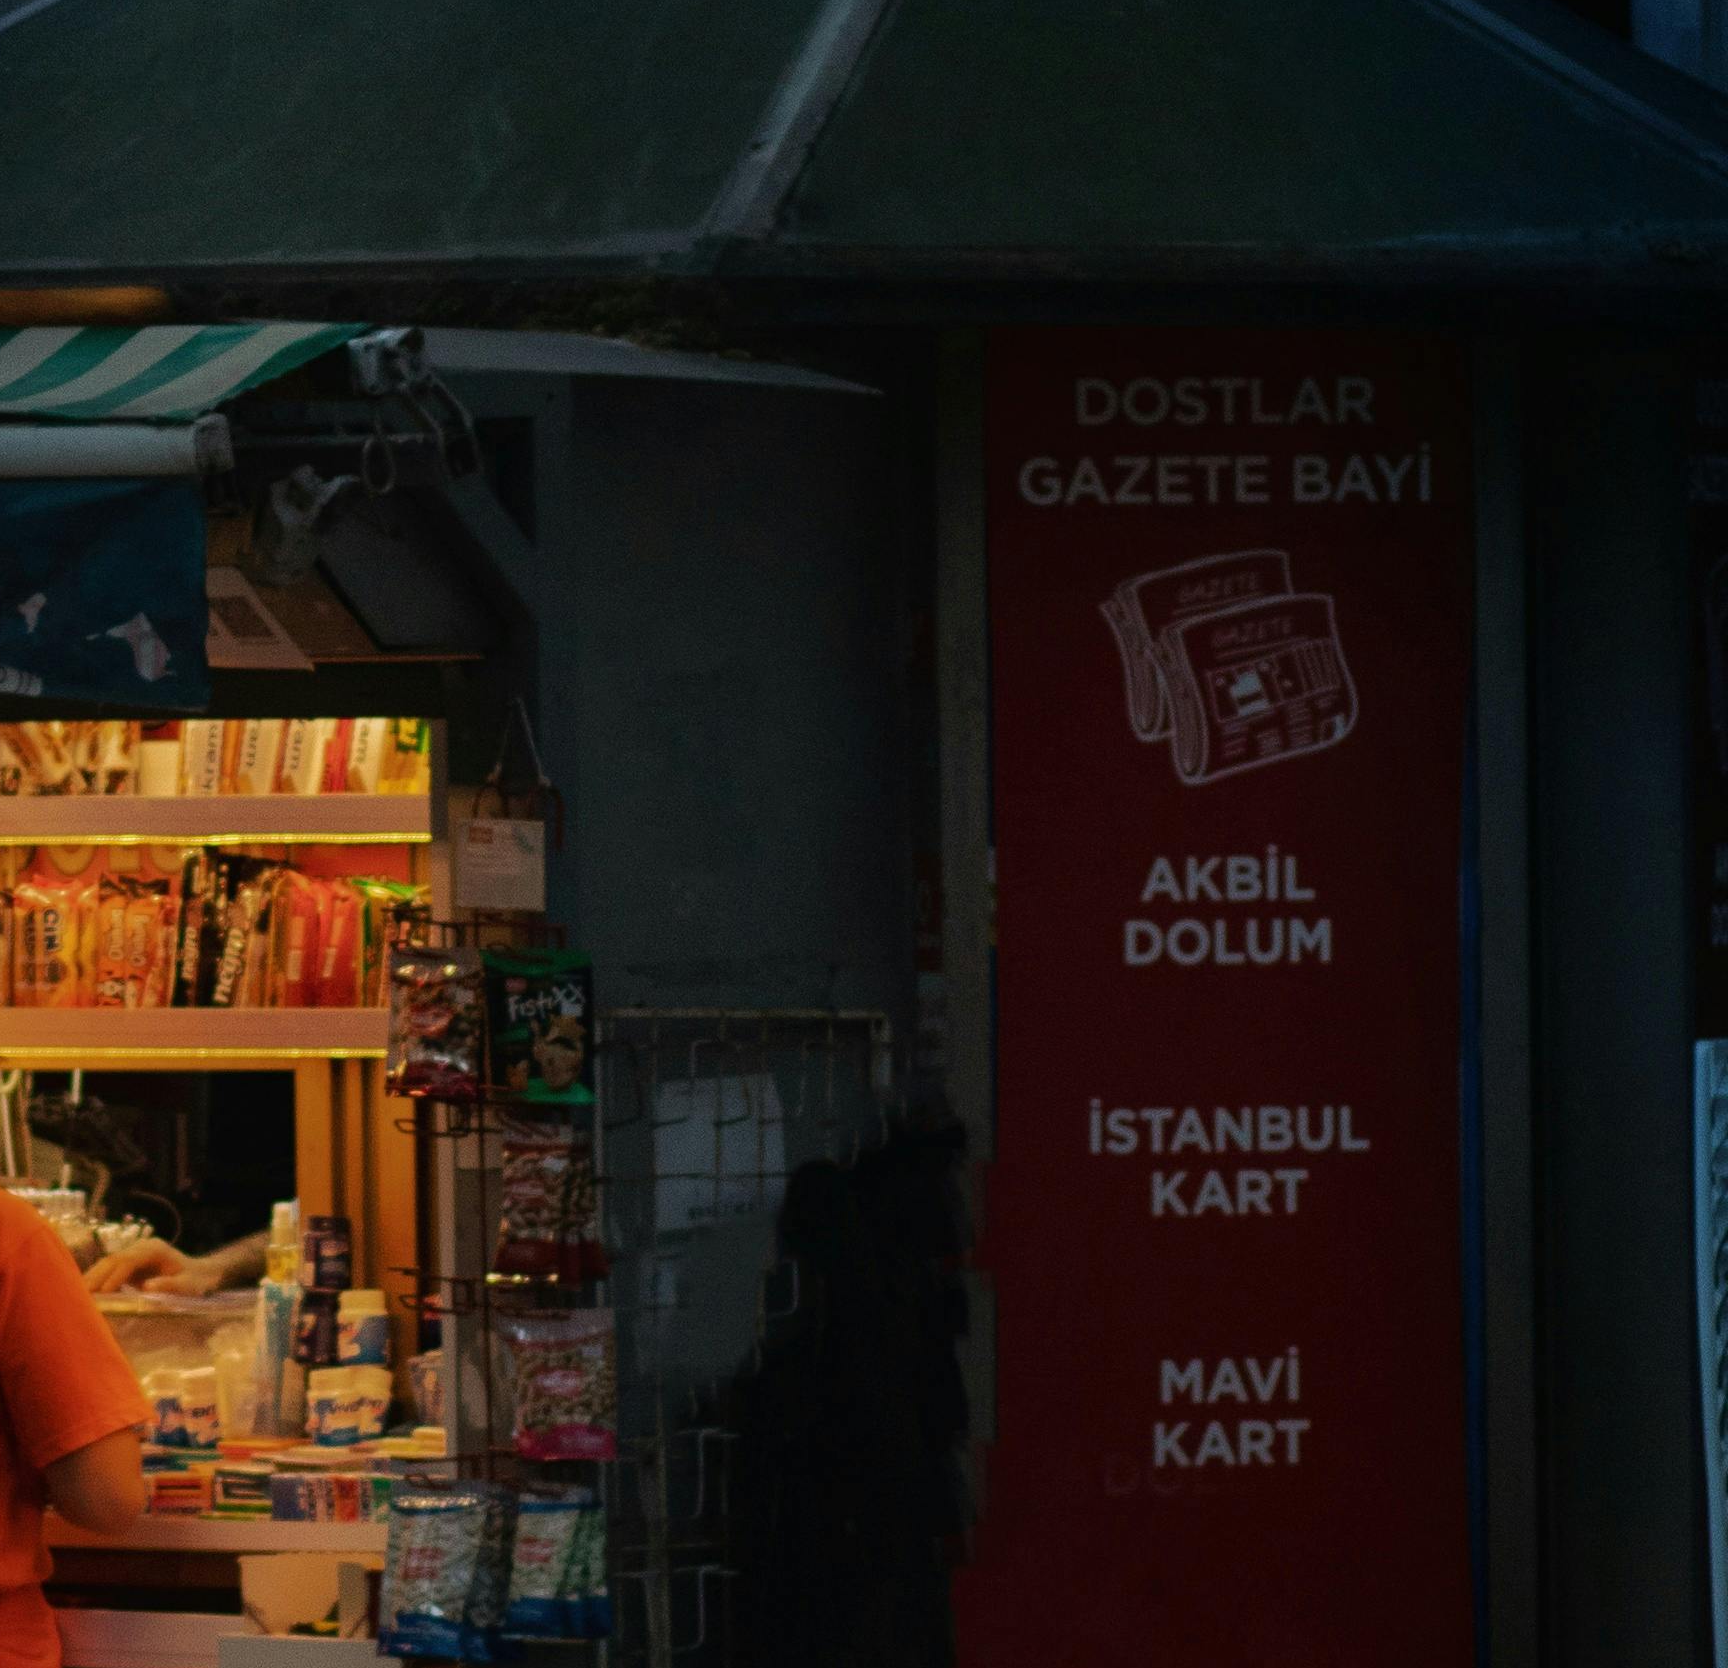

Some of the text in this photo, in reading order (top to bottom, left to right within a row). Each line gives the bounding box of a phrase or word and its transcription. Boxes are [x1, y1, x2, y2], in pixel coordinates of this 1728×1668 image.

[1075, 378, 1375, 427] DOSTLAR
[1017, 442, 1433, 507] GAZETE BAYİ
[1140, 844, 1317, 904] AKBİL
[211, 927, 246, 1003] negro
[1122, 919, 1332, 966] DOLUM
[1088, 1098, 1371, 1156] İSTANBUL
[1149, 1169, 1310, 1218] KART
[1159, 1346, 1301, 1405] MAVİ
[1152, 1418, 1312, 1469] KART
